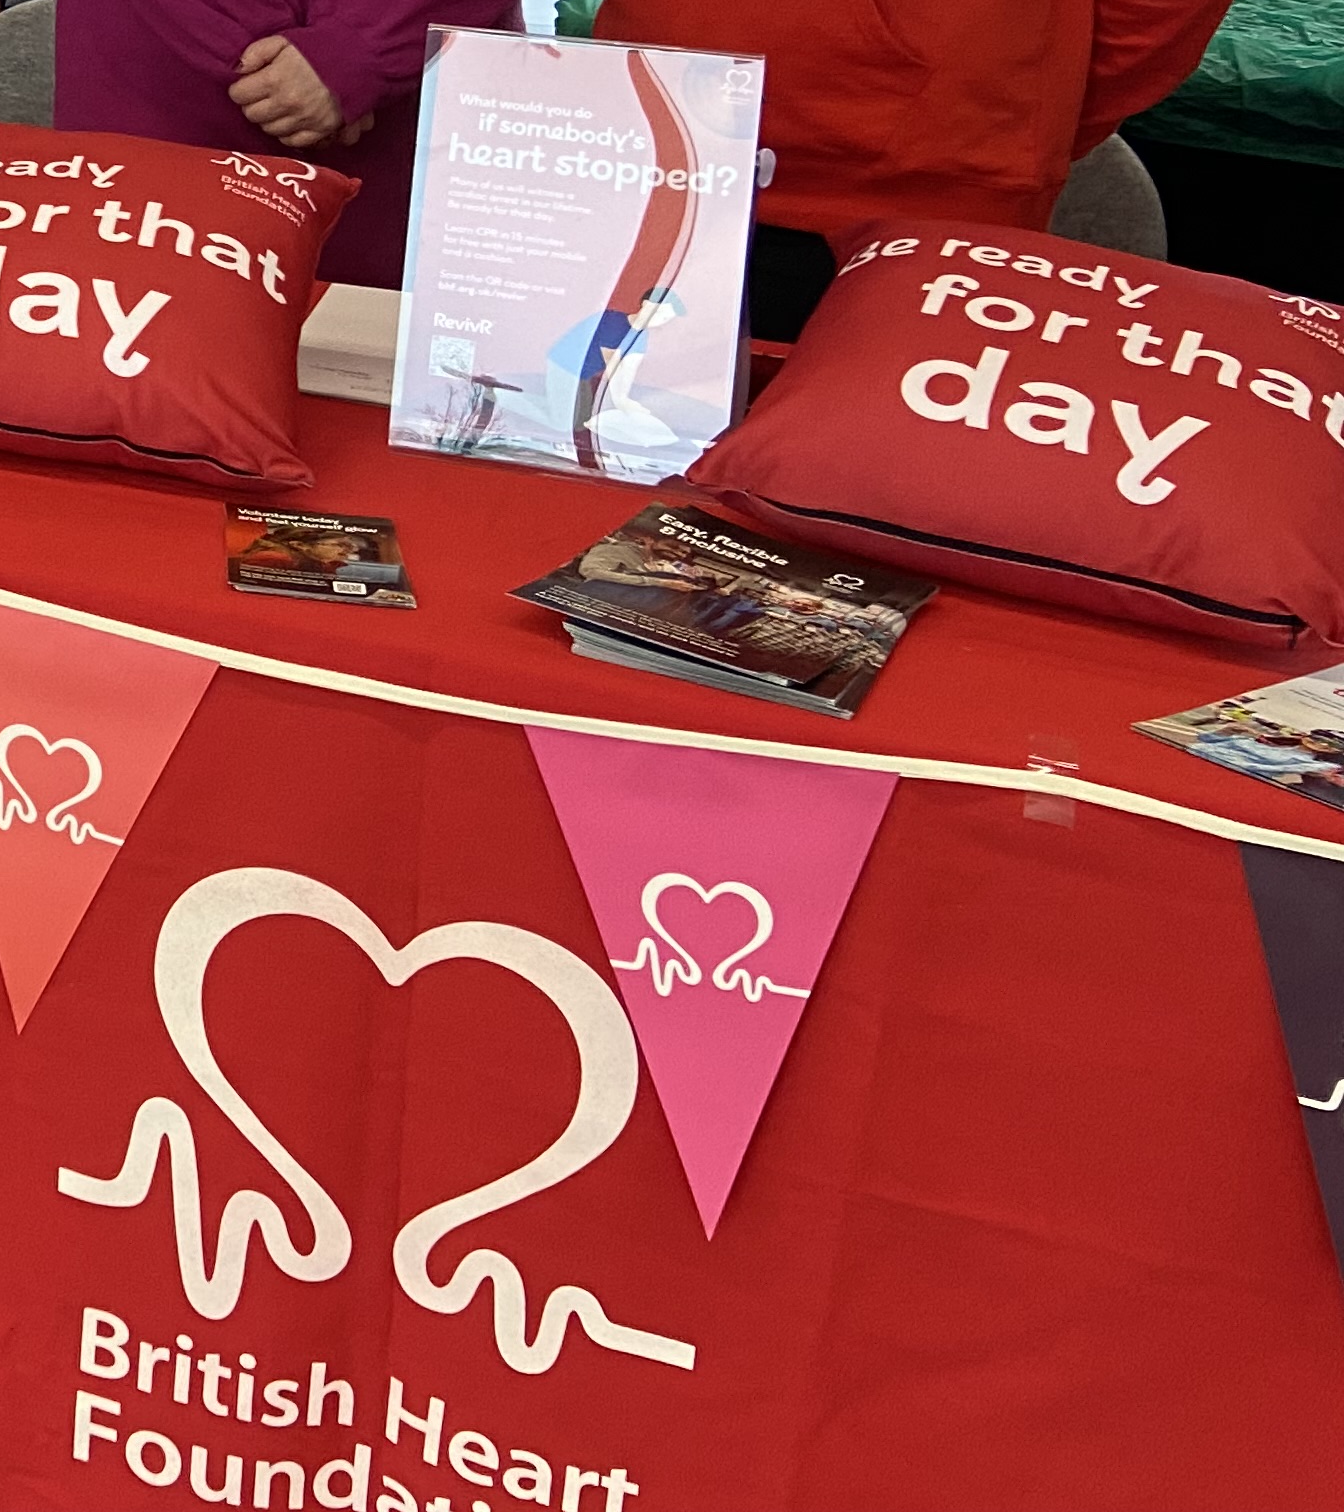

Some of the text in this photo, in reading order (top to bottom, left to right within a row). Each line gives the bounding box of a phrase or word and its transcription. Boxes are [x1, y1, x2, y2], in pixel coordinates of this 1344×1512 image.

[460, 92, 593, 120] What would you do
[478, 112, 646, 153] if somebody's
[221, 175, 269, 196] British
[448, 132, 739, 197] heart stopped?
[223, 184, 301, 228] Foundation
[94, 201, 287, 305] that
[838, 237, 1160, 309] Be ready
[433, 313, 493, 335] RevivR
[920, 273, 1089, 344] for
[901, 346, 1212, 506] day
[677, 533, 767, 569] inclusive
[713, 535, 789, 566] flexible
[78, 1304, 640, 1512] British Heart
